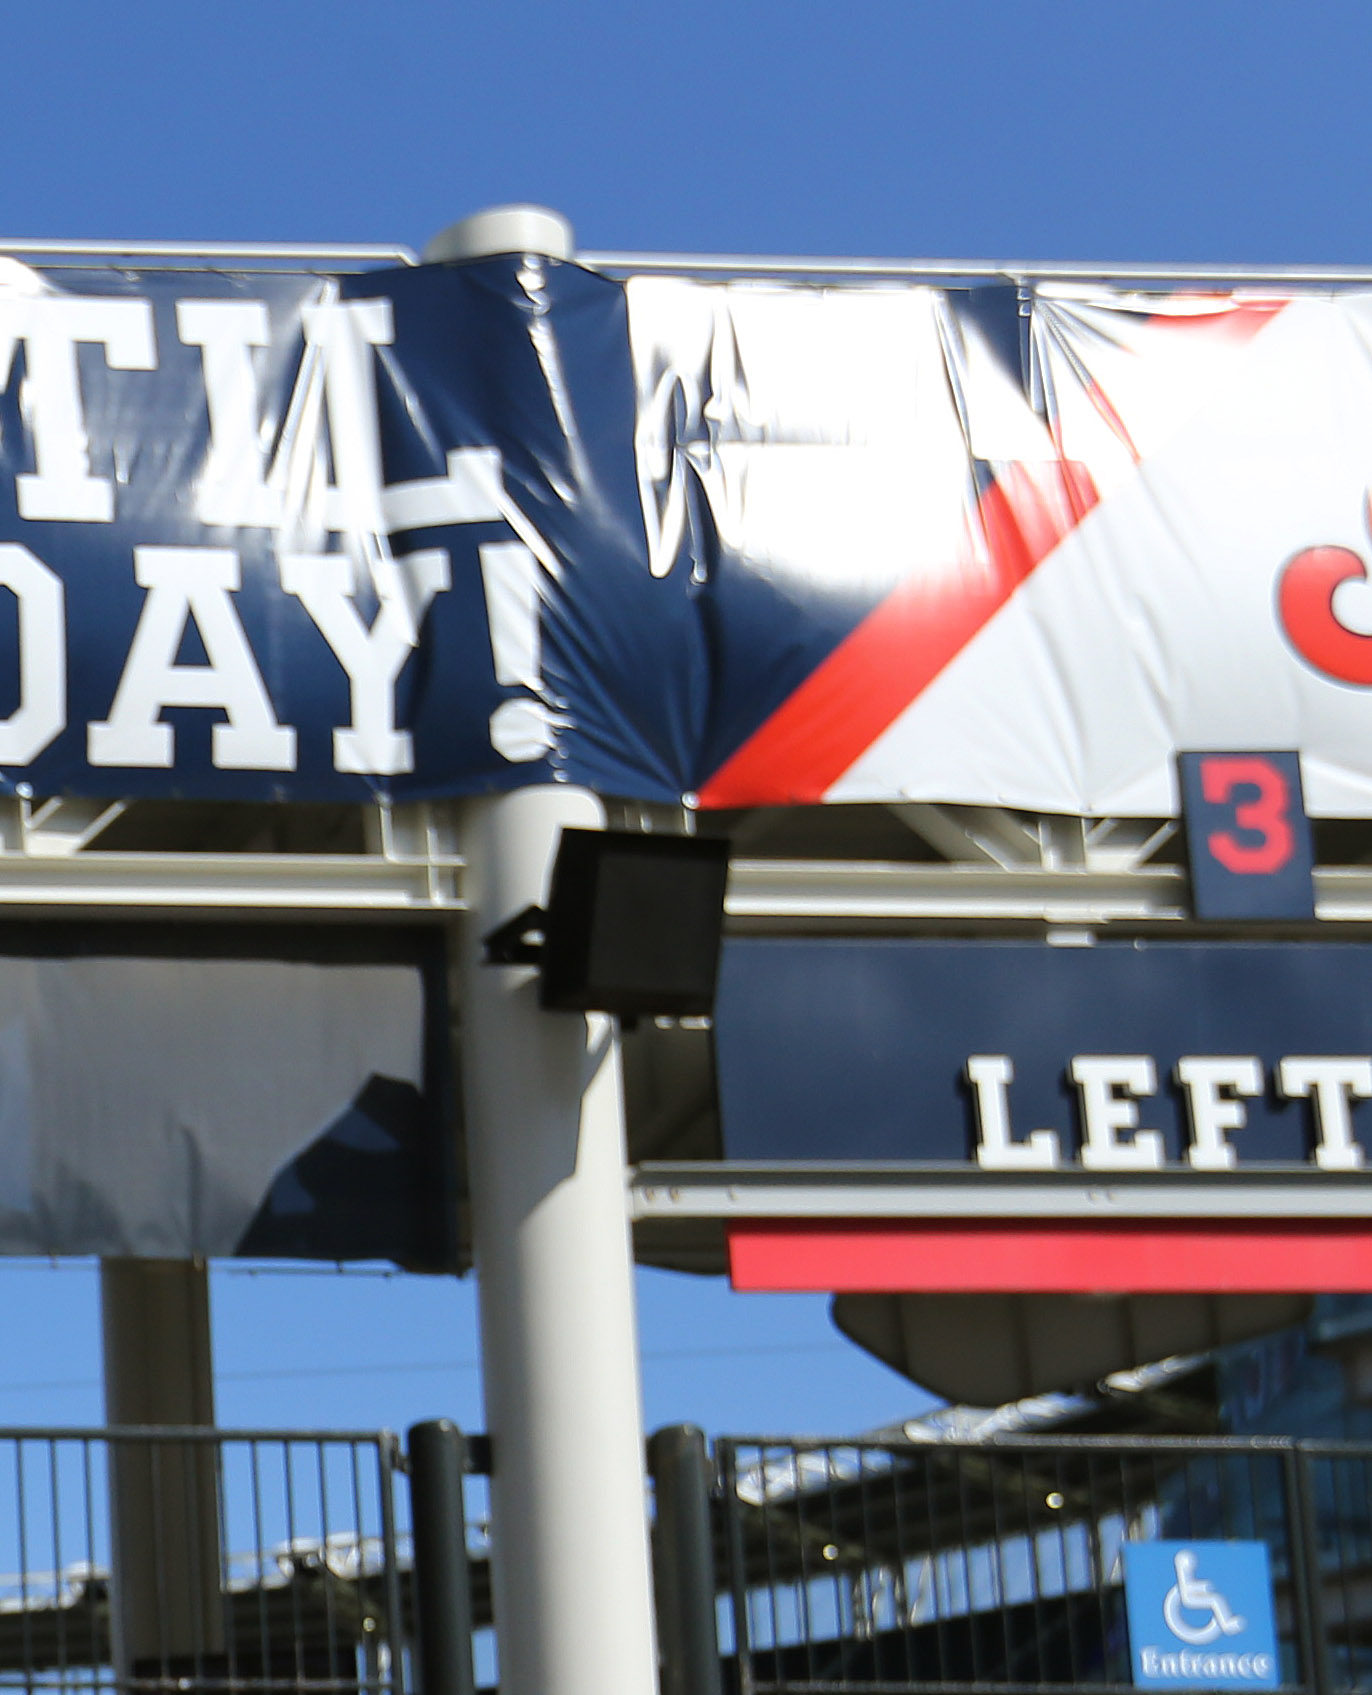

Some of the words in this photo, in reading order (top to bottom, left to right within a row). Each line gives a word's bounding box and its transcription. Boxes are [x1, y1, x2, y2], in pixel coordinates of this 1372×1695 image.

[1201, 757, 1295, 875] 3
[967, 1055, 1372, 1170] LEFT
[1140, 1645, 1272, 1679] Entrance
